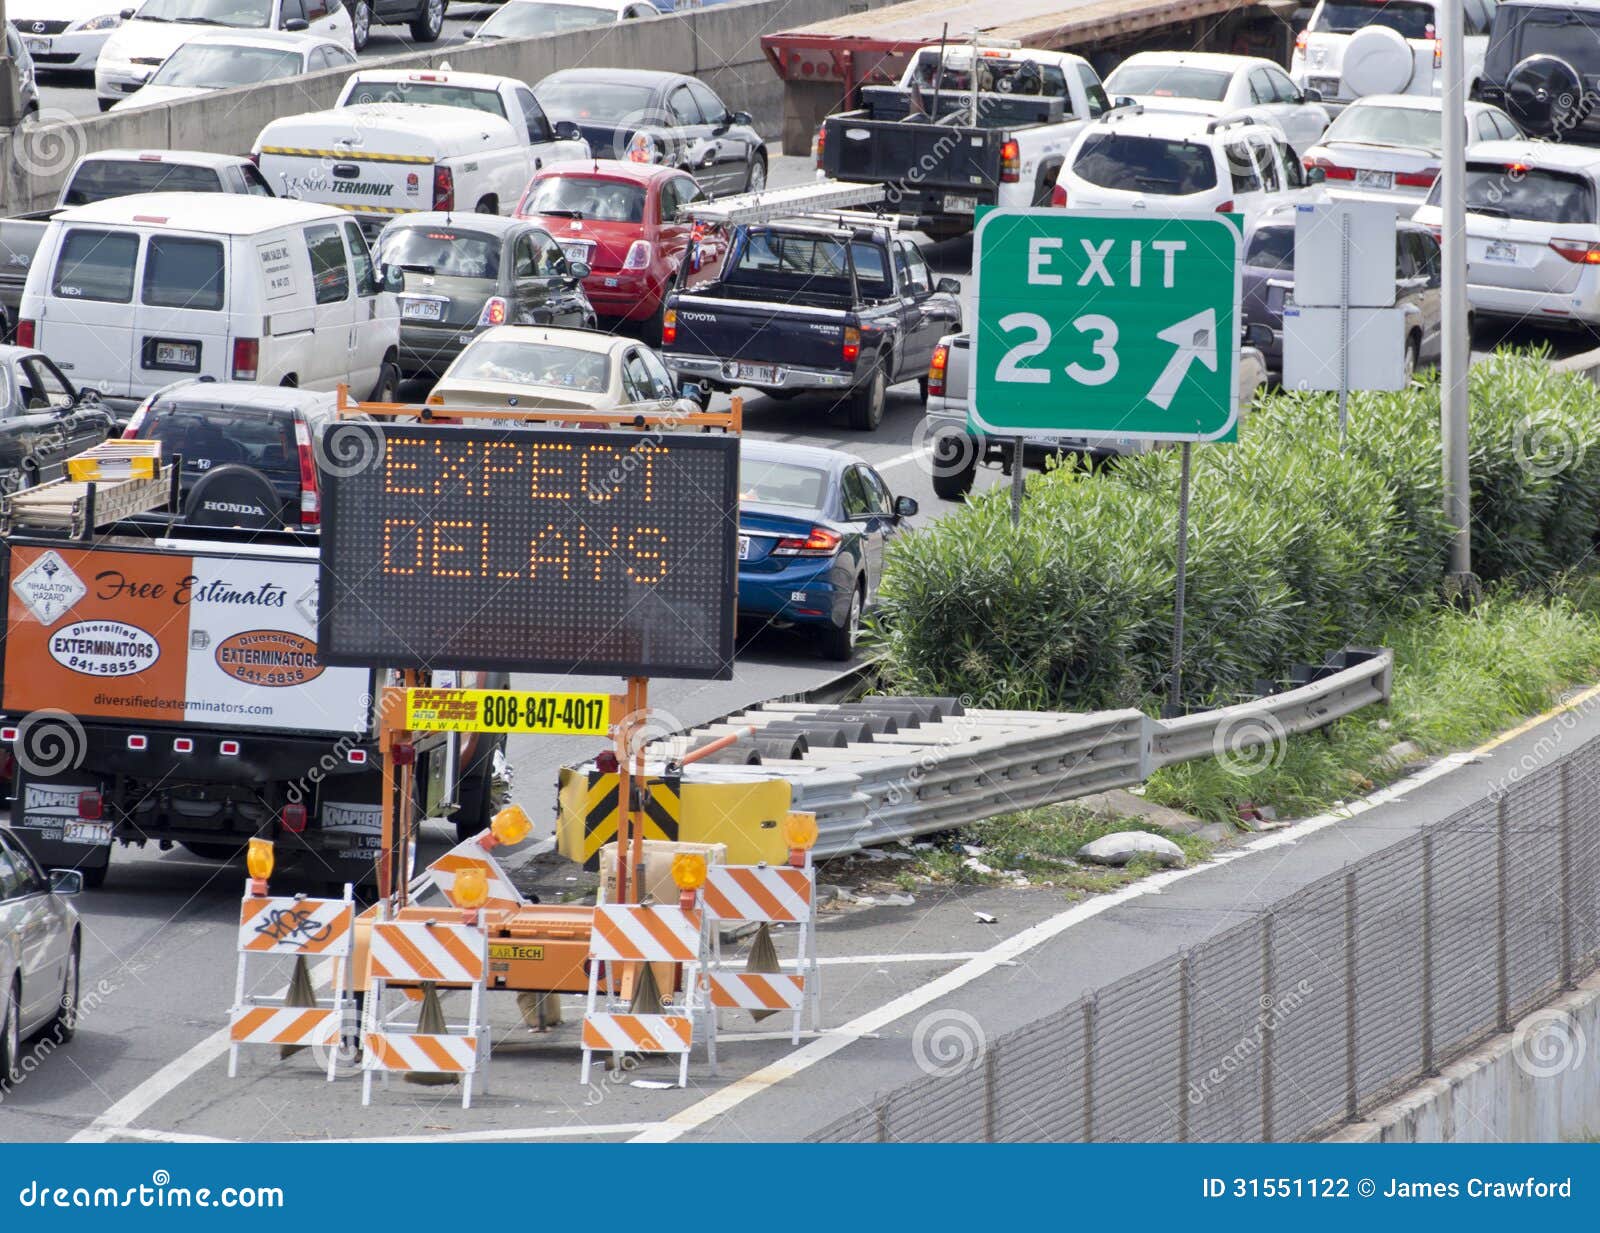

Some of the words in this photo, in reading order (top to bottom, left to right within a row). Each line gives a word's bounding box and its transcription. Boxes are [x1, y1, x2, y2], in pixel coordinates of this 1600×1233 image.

[1027, 236, 1187, 288] EXIT
[681, 311, 717, 322] TOYOTA
[994, 312, 1120, 386] 23
[385, 438, 670, 502] EXPECT
[203, 500, 265, 516] HONDA
[383, 519, 667, 584] DELAYS
[95, 570, 167, 601] Free
[173, 575, 287, 608] Estimates
[72, 624, 138, 640] Diversified
[239, 634, 305, 650] Diversified
[54, 637, 153, 659] EXTERMINATORS
[69, 656, 137, 673] 841-5855
[235, 666, 305, 684] 841-5855
[94, 693, 274, 716] diversifiedexterminators.com
[483, 695, 604, 730] 808-847-4017
